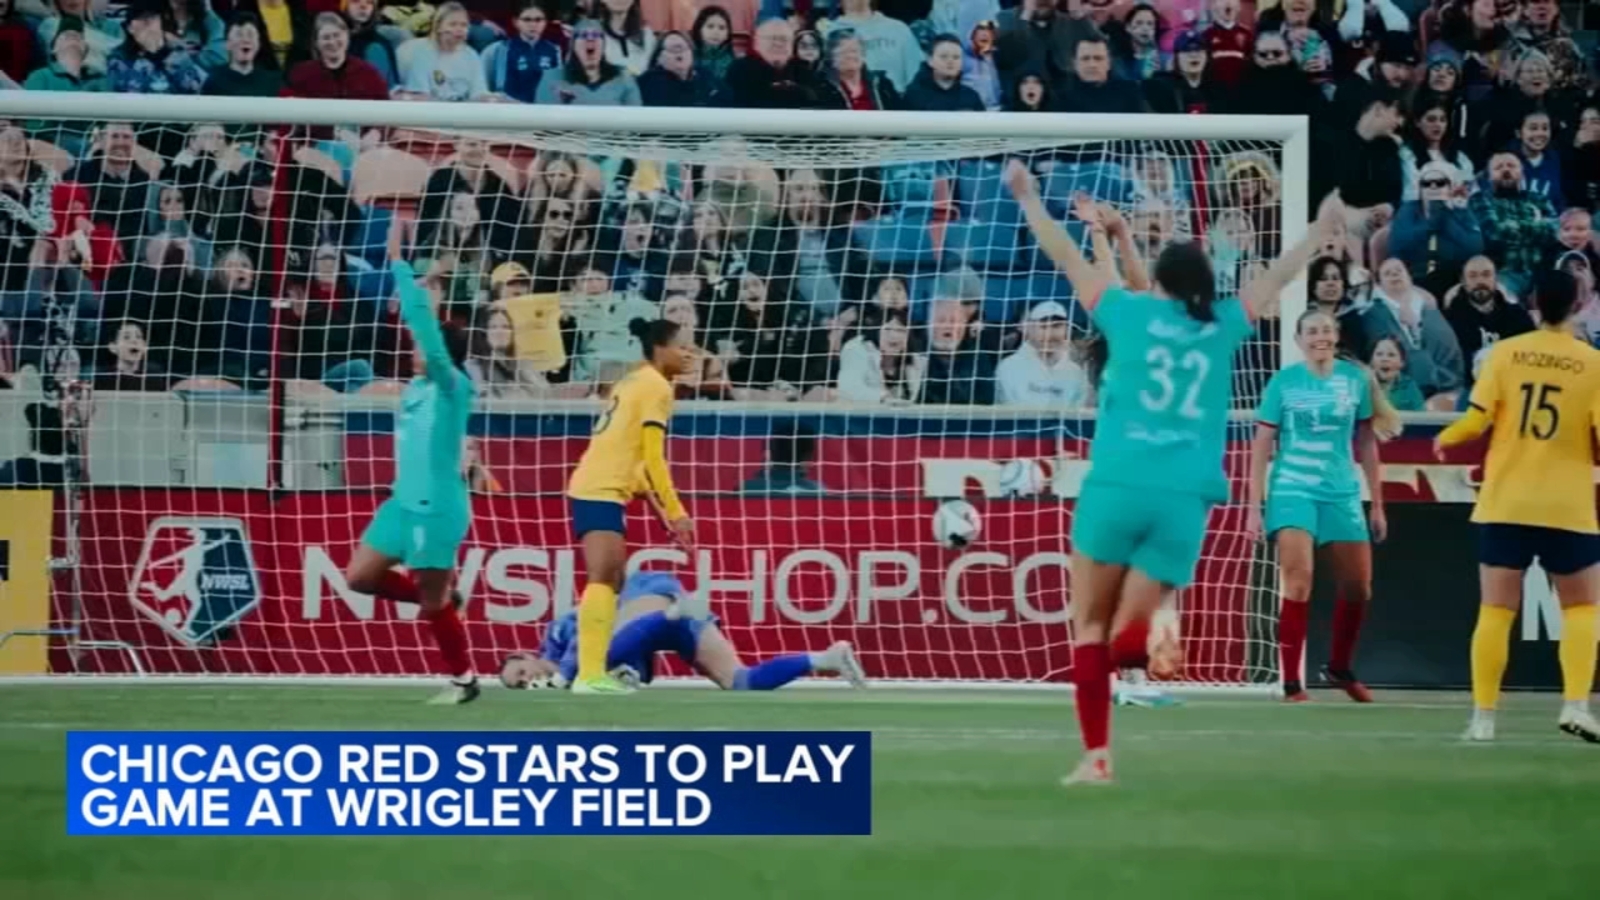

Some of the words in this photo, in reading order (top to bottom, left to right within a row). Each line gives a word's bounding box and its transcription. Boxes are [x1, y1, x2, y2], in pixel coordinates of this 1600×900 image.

[1139, 345, 1211, 419] 32
[1512, 351, 1585, 374] MOZINGO
[1520, 382, 1563, 440] 15
[201, 574, 250, 590] NWSL
